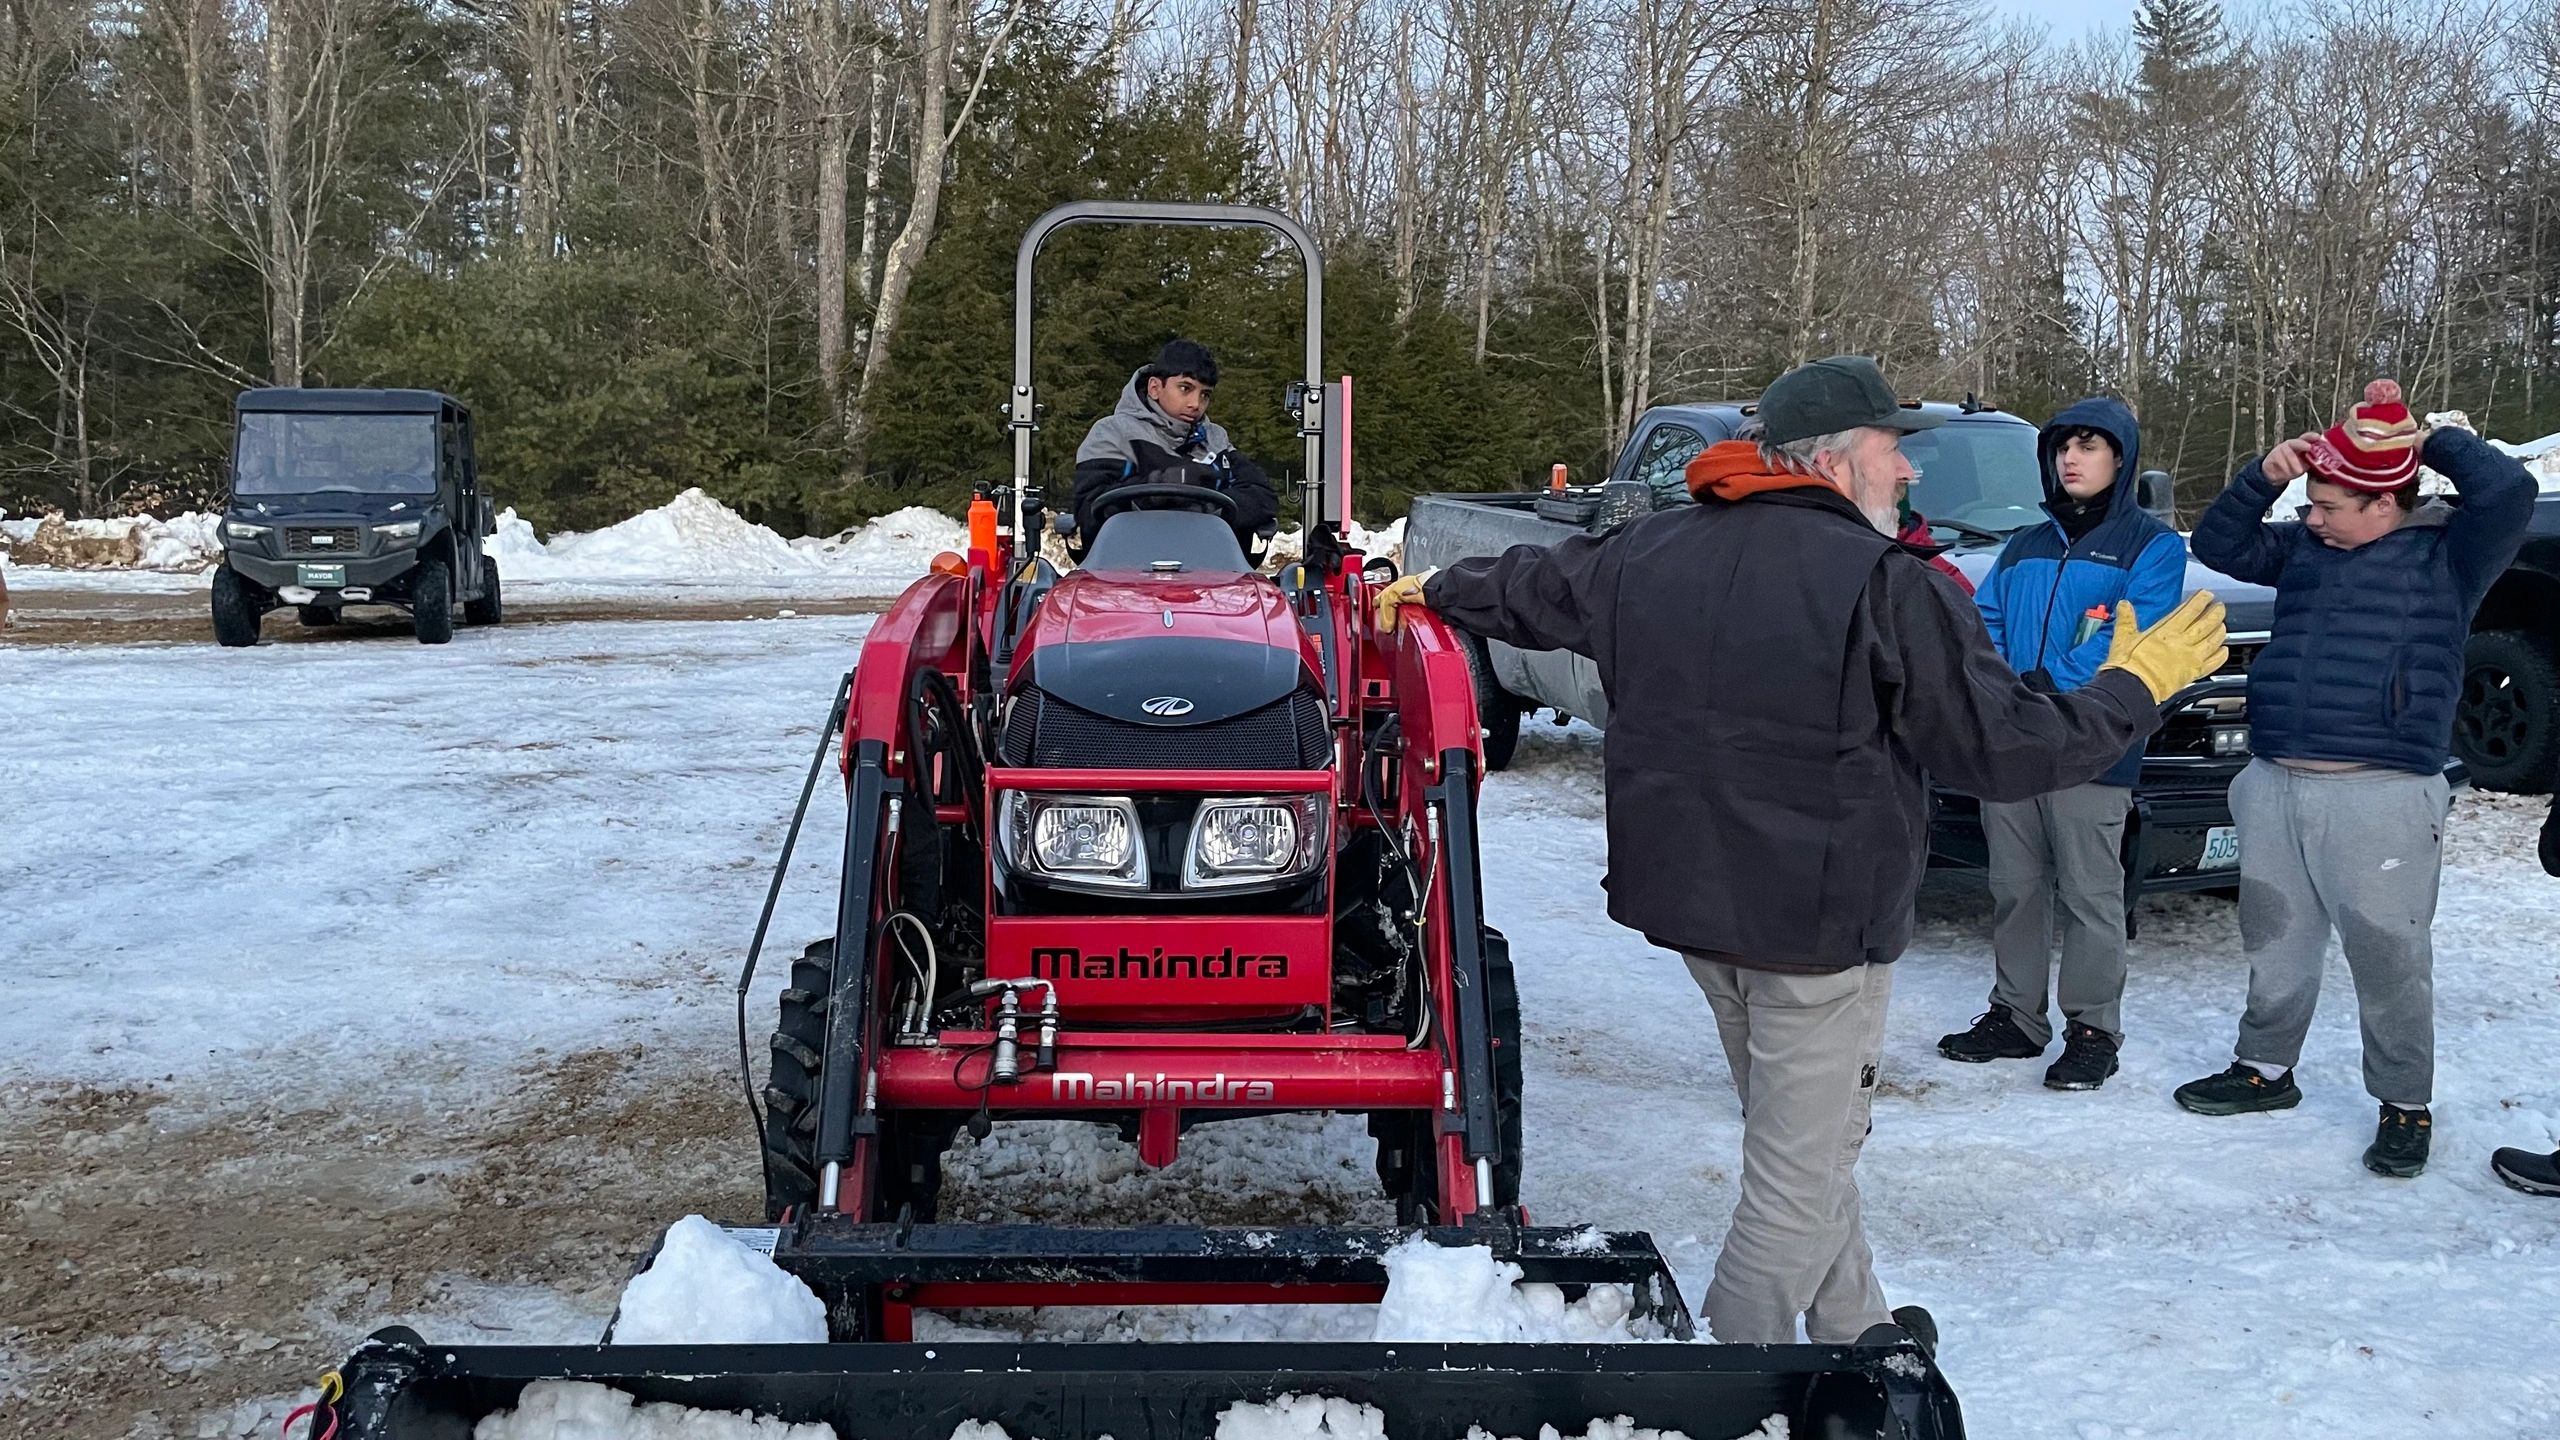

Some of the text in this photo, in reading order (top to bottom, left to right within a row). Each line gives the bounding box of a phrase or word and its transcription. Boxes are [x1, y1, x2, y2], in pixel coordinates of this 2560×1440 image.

[307, 572, 333, 580] MAYOR
[2207, 837, 2238, 860] 505
[1030, 947, 1289, 980] Mahindra
[1052, 1072, 1274, 1101] Mahindra
